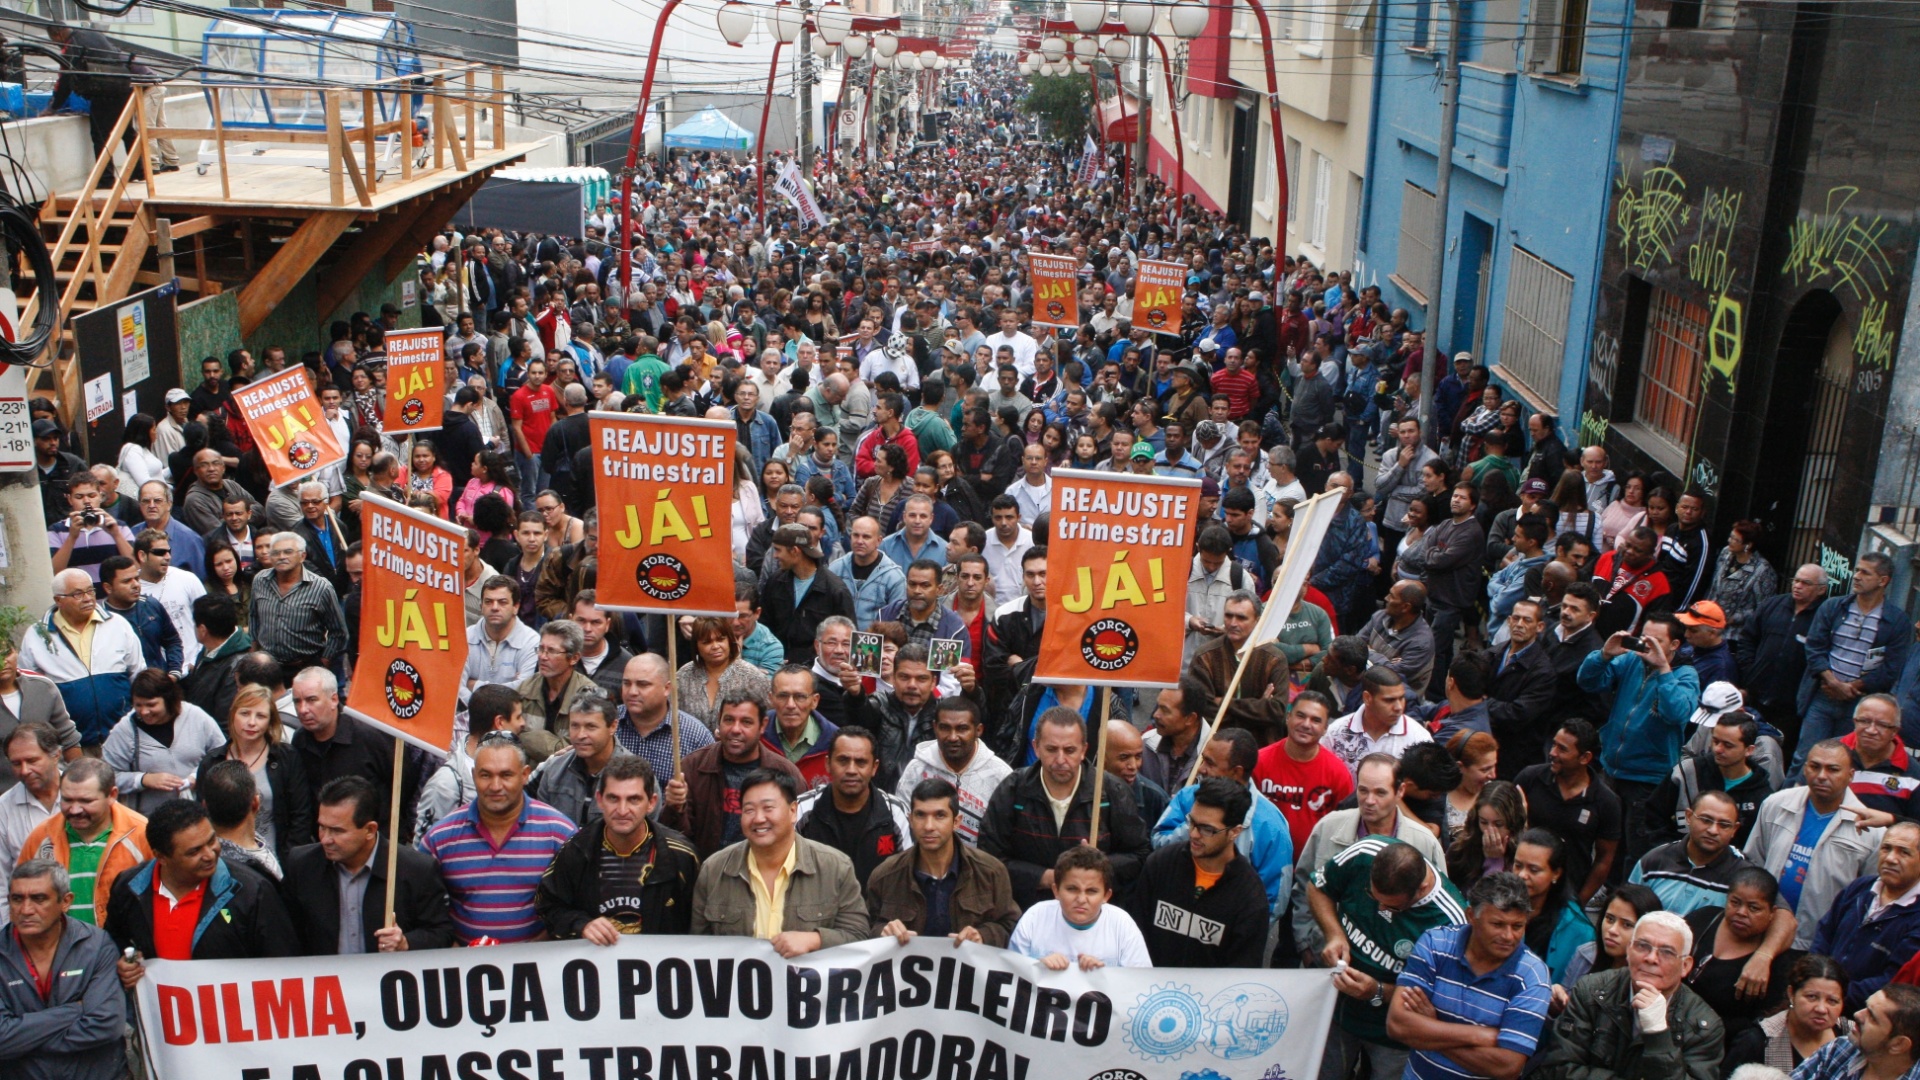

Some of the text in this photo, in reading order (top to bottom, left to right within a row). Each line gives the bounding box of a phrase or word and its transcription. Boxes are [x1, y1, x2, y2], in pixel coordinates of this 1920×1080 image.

[1033, 258, 1074, 270] REAJUSTE
[1034, 268, 1074, 278] trimestral
[1141, 264, 1184, 278] REAJUSTE
[1038, 279, 1072, 299] JÁ!
[1140, 274, 1182, 287] trimestral
[1140, 286, 1176, 308] JÁ!
[389, 336, 439, 353] REAJUSTE
[389, 349, 440, 366] trimestral
[242, 372, 305, 408] REAJUSTE
[393, 365, 434, 401] JÁ!
[1857, 366, 1883, 394] 805
[88, 400, 114, 420] ENTRADA
[247, 385, 311, 420] trimestral
[268, 404, 317, 450] JÁ!
[601, 427, 726, 459] REAJUSTE
[602, 455, 725, 485] trimestral
[1060, 486, 1188, 520] REAJUSTE
[614, 488, 713, 549] JÁ!
[1058, 516, 1185, 547] trimestral
[371, 512, 459, 568] REAJUSTE
[369, 542, 461, 596] trimestral
[642, 555, 682, 572] FORÇA
[638, 579, 690, 600] SINDICAL
[1061, 549, 1167, 614] JÁ!
[376, 588, 450, 651] JÁ!
[1090, 620, 1131, 638] FORÇA
[390, 659, 419, 684] FORÇA
[1082, 646, 1136, 670] SINDICAL
[385, 685, 424, 718] SINDICAL
[156, 974, 367, 1046] DILMA,
[379, 961, 549, 1038] OUÇA
[562, 958, 601, 1022] O
[616, 957, 773, 1020] POVO
[786, 954, 1113, 1048] BRASILEIRO
